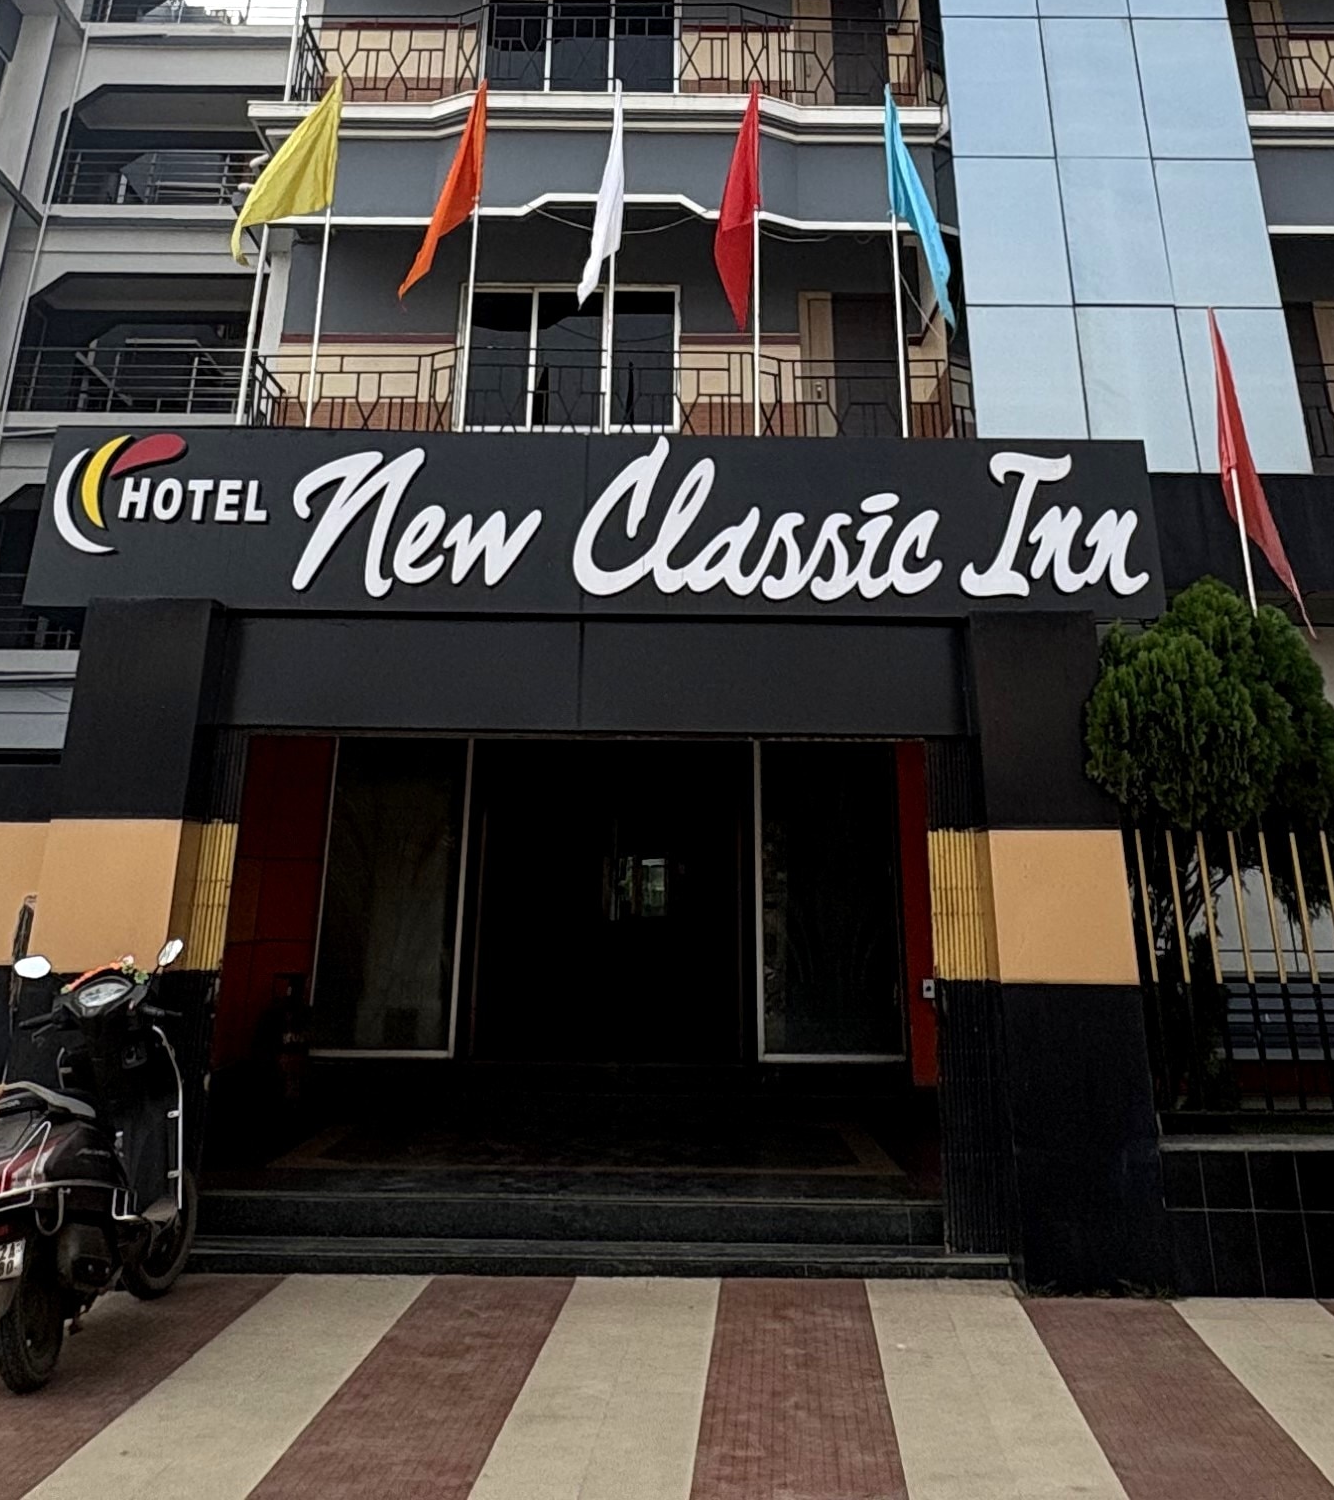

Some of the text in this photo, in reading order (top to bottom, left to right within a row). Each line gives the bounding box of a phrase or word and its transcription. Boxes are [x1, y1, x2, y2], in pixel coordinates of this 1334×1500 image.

[116, 435, 1150, 601] HOTEL New Classic Inn
